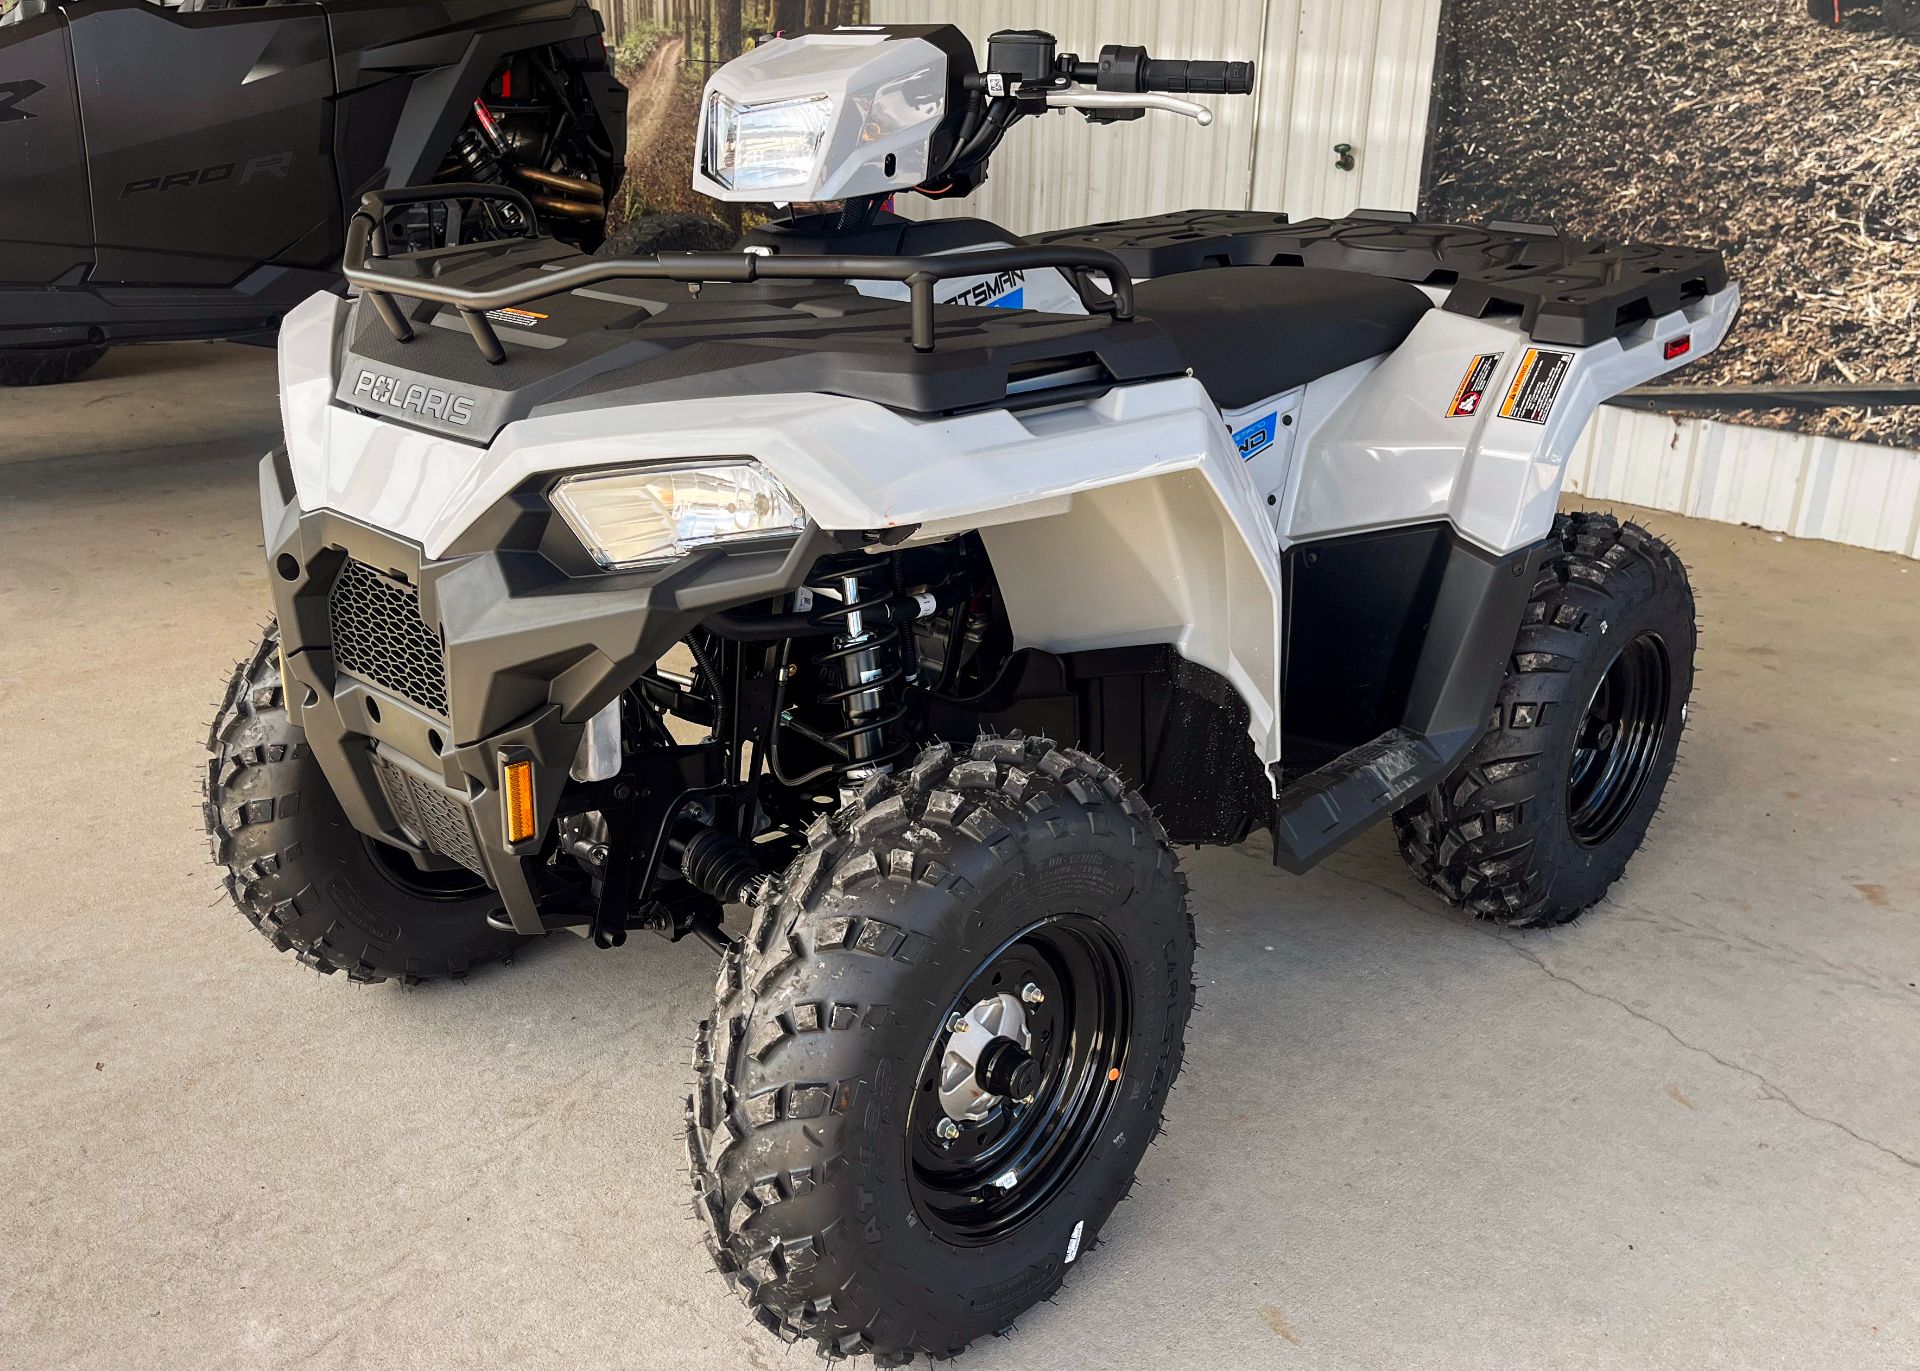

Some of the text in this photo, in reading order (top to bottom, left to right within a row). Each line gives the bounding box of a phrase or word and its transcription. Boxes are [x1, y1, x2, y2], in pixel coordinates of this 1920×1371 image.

[119, 150, 296, 201] PRO R
[353, 370, 475, 426] POLARIS
[1512, 365, 1529, 393] WARNING
